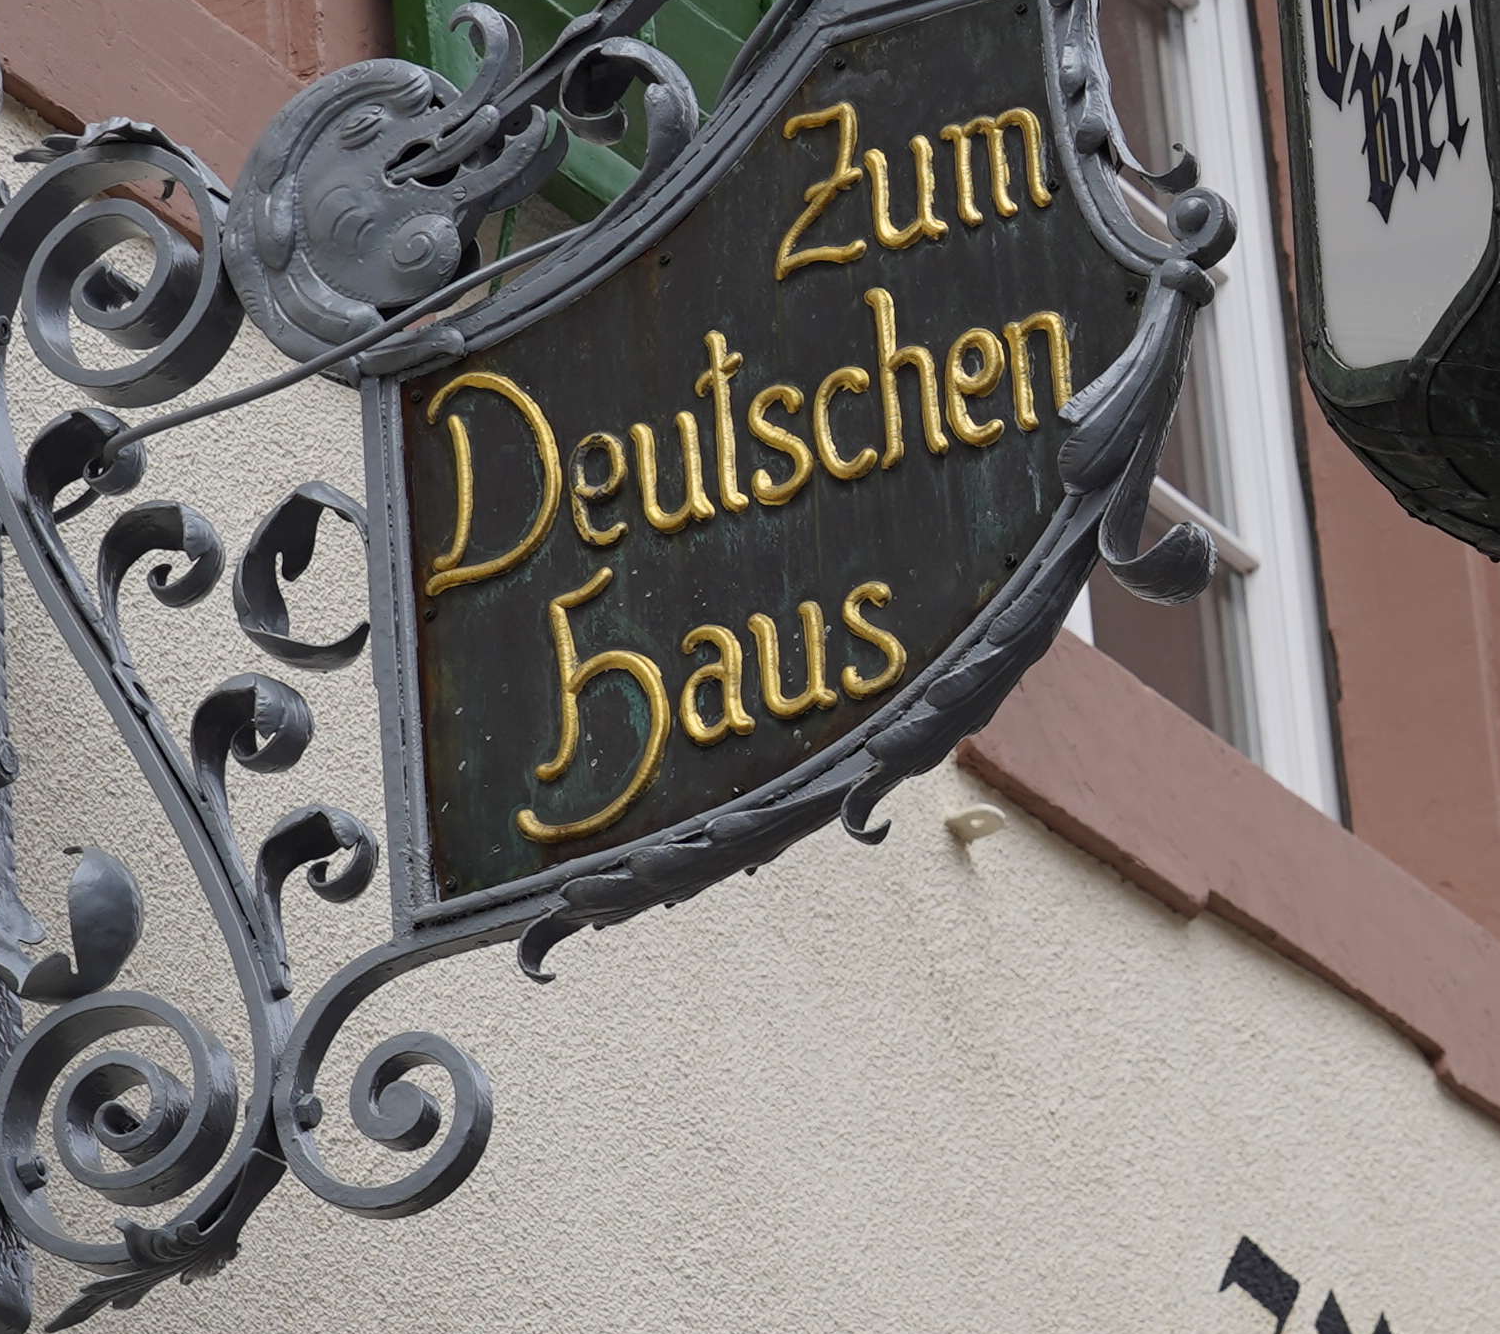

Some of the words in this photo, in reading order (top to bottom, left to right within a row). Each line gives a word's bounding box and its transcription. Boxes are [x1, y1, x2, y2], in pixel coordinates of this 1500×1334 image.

[774, 101, 1053, 280] Zum
[1347, 4, 1470, 225] Bier
[425, 287, 1074, 598] Deutschen
